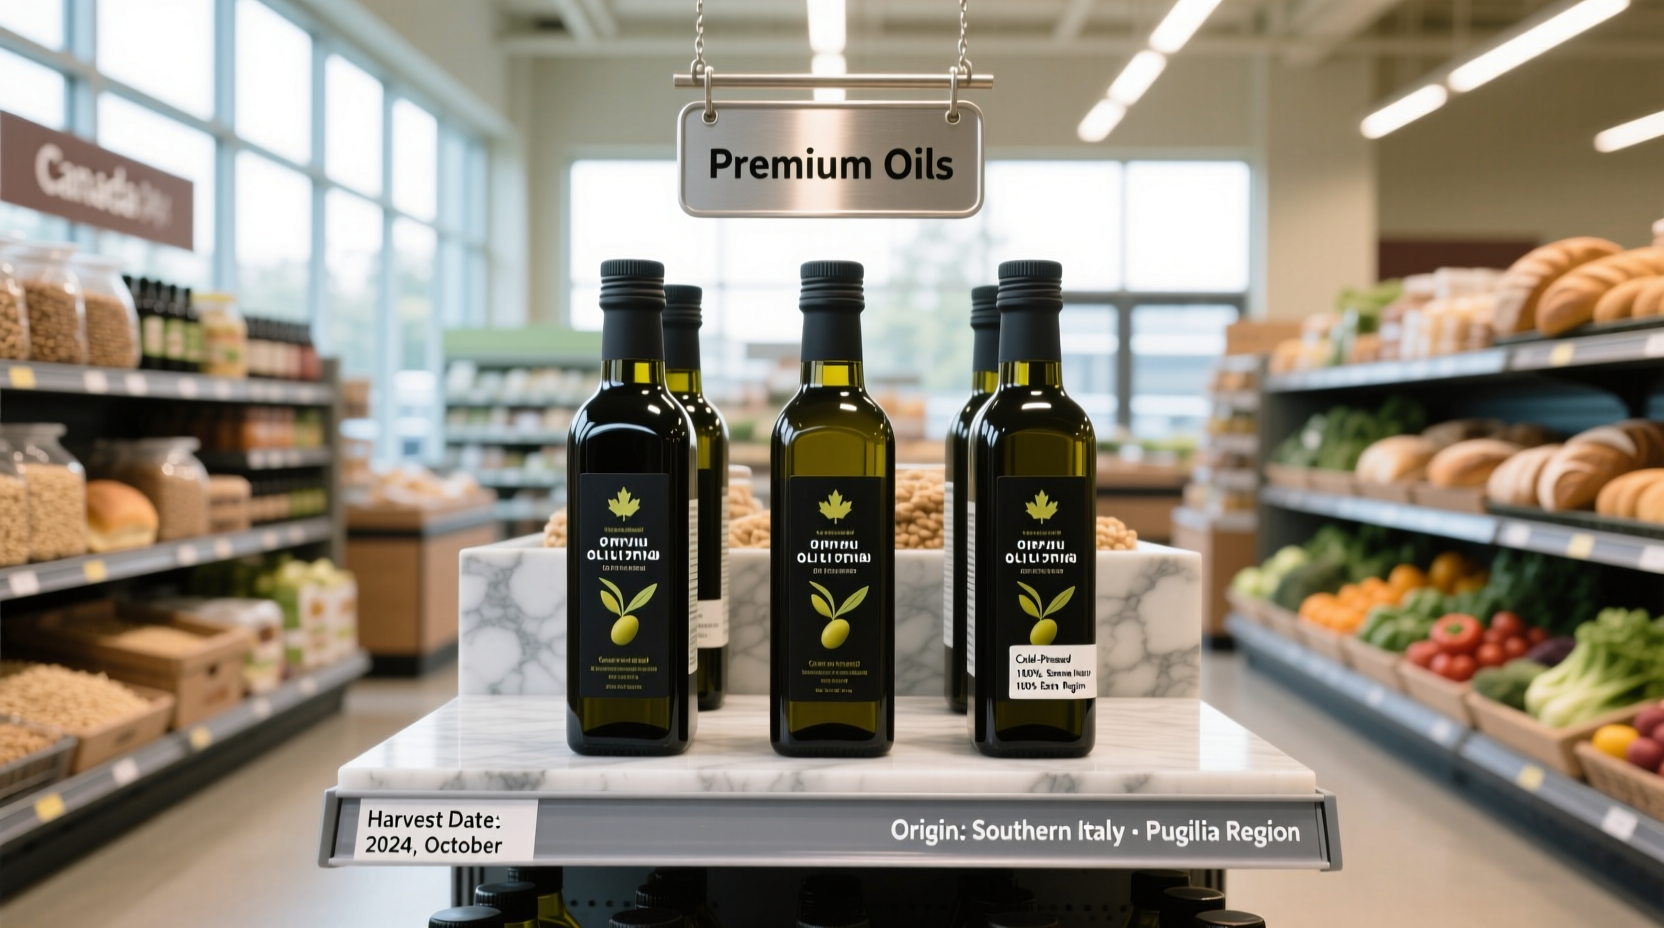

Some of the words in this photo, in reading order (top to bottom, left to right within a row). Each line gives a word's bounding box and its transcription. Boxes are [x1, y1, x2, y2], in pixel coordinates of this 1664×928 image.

[710, 147, 872, 180] Premium
[884, 147, 954, 180] Oils
[368, 809, 444, 829] Harvest
[449, 810, 501, 829] Date:
[365, 835, 417, 857] 2024,
[424, 835, 503, 854] October
[891, 818, 966, 846] Origin:
[972, 818, 1072, 842] Southern
[1078, 818, 1125, 847] Italy
[1146, 818, 1220, 847] Pugilia
[1226, 818, 1301, 848] Region
